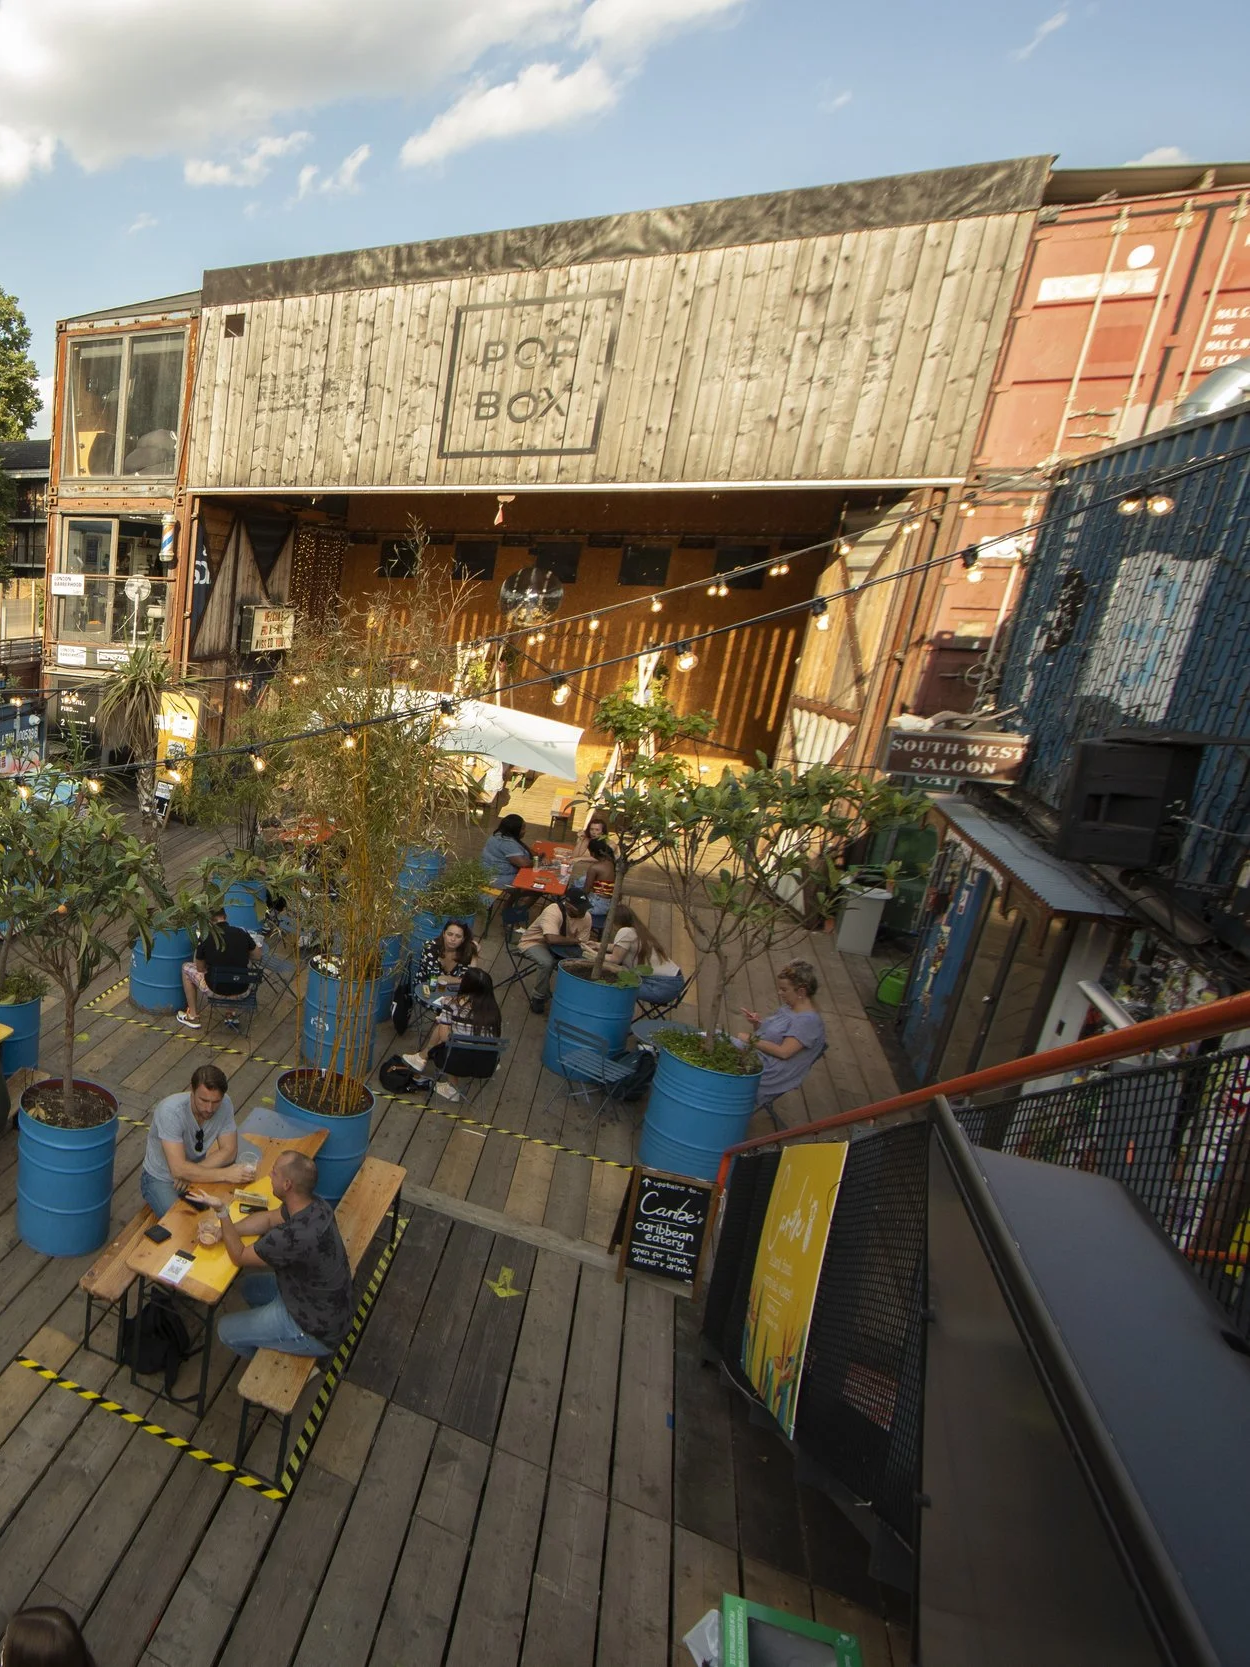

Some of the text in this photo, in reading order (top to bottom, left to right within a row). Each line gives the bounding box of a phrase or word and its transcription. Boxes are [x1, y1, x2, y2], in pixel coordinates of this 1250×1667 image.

[481, 335, 579, 372] POP
[474, 387, 573, 424] BOX
[60, 718, 66, 726] 2
[892, 739, 1026, 760] SOUTH-WEST
[910, 757, 997, 774] SALOON
[653, 1181, 685, 1191] upstairs
[635, 1221, 694, 1242] caribbean
[645, 1233, 684, 1251] eatery
[631, 1247, 690, 1267] open for lunch,
[633, 1255, 659, 1266] dinner
[666, 1263, 692, 1275] drinks
